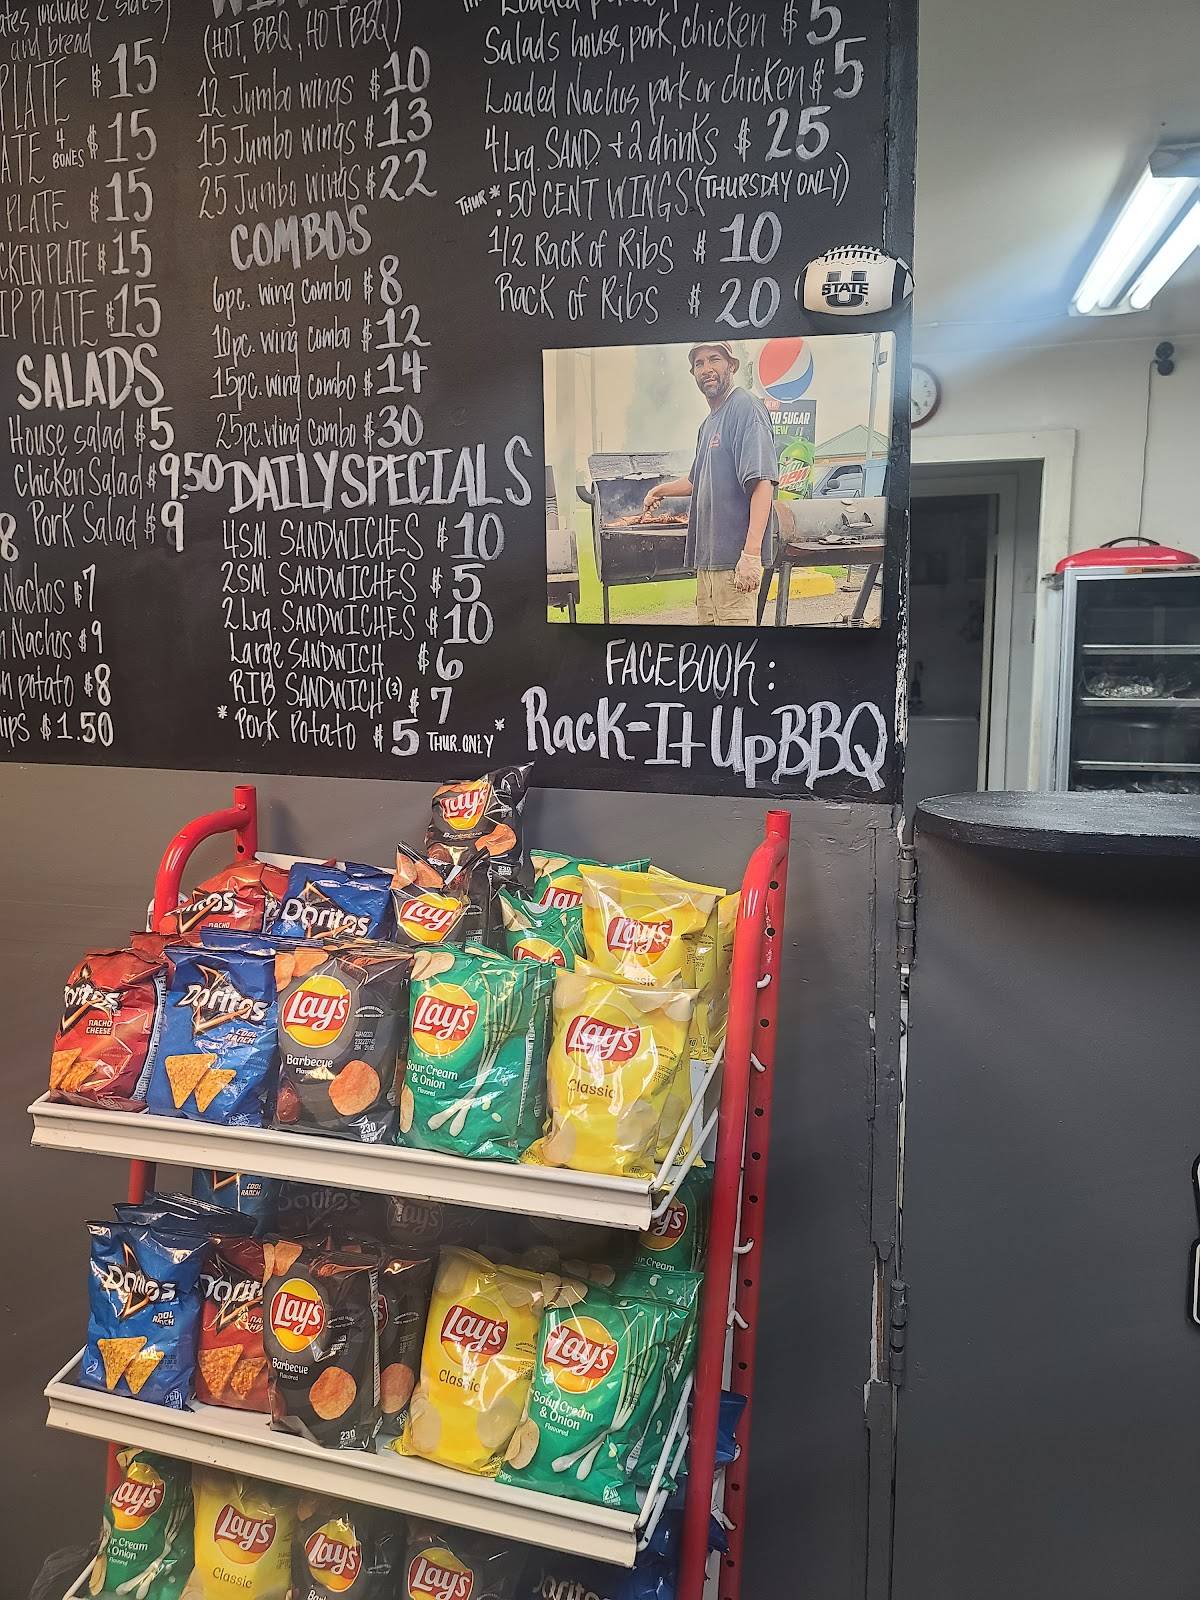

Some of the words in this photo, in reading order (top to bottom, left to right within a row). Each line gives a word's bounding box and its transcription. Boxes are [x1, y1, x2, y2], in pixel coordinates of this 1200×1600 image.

[11, 27, 40, 61] and
[49, 22, 93, 58] bread
[306, 5, 347, 50] HOT
[483, 17, 560, 65] Salads
[681, 1, 767, 50] chicken
[0, 57, 70, 131] PLATE
[197, 77, 227, 118] 12
[229, 67, 292, 117] Jumbo
[299, 73, 355, 126] wings
[486, 70, 558, 119] Loaded
[566, 62, 640, 117] Nachos
[649, 62, 692, 127] pork
[696, 78, 716, 103] or
[721, 54, 805, 107] chicken
[52, 148, 85, 169] BONES
[56, 128, 67, 150] 4
[196, 123, 228, 169] 15
[231, 116, 293, 165] Jumbo
[300, 119, 357, 168] wings
[545, 126, 601, 171] SAND.
[648, 112, 719, 166] drinks
[6, 190, 69, 233] PLATE
[199, 174, 228, 219] 25
[232, 166, 298, 216] Jumbo
[304, 163, 361, 222] wings
[541, 175, 600, 221] CENT
[606, 167, 693, 223] WINGS
[230, 204, 372, 271] COMBOS
[487, 225, 528, 268] 1/2
[536, 230, 586, 270] Rack
[588, 229, 609, 269] of
[618, 226, 674, 275] Ribs
[47, 240, 94, 286] PLATE
[213, 276, 251, 321] 6pc.
[258, 276, 297, 327] wing
[494, 272, 556, 320] Rack
[567, 275, 590, 321] of
[600, 271, 660, 325] Ribs
[821, 282, 869, 297] STATE
[31, 289, 98, 347] PLATE
[212, 323, 255, 368] 10pc.
[260, 322, 299, 374] wing
[17, 343, 165, 411] SALADS
[265, 368, 302, 421] wing
[9, 414, 67, 456] House
[783, 411, 811, 425] SUGAR
[89, 453, 144, 500] Salad
[27, 499, 76, 549] Pork
[83, 497, 138, 551] Salad
[280, 512, 424, 561] SANDWICHES
[3, 562, 65, 614] Nachos
[278, 562, 417, 602] SANDWICHES
[12, 617, 72, 660] Nachos
[282, 600, 416, 641] SANDWICHES
[230, 632, 284, 674] Large
[288, 638, 385, 680] SANDWICH
[18, 663, 74, 710] potato
[229, 669, 276, 706] RIB
[285, 672, 385, 719] SANDWICH
[235, 707, 280, 745] Pork
[289, 711, 356, 751] Potato
[279, 897, 371, 942] Doritos
[609, 917, 673, 955] Lay's
[88, 1019, 113, 1027] NACHO
[178, 984, 269, 1021] Doritos
[285, 991, 350, 1031] Lay's
[414, 996, 477, 1041] Lay's
[86, 1027, 112, 1036] CHEESE
[225, 1034, 256, 1045] RANCH
[235, 1028, 257, 1039] COOL
[567, 1016, 639, 1060] Lay's
[286, 1053, 334, 1068] Barbecue
[406, 1059, 425, 1074] Sour
[426, 1063, 459, 1081] Cream
[411, 1073, 419, 1084] &
[420, 1075, 446, 1090] Onion
[567, 1077, 617, 1099] Classic
[359, 1121, 377, 1134] 230
[245, 1182, 262, 1190] COOL
[273, 1292, 324, 1338] Lay's
[442, 1305, 506, 1353] Lay's
[272, 1356, 309, 1374] Barbecue
[547, 1326, 617, 1374] Lay's
[539, 1407, 549, 1418] &
[549, 1410, 581, 1431] Onion
[560, 1400, 594, 1423] Cream
[340, 1431, 356, 1442] 230
[111, 1481, 162, 1517] Lay's
[118, 1537, 148, 1551] Cream
[216, 1507, 275, 1553] Lay's
[112, 1546, 137, 1561] Onion
[308, 1534, 358, 1576] Lay's
[212, 1566, 254, 1590] Classic
[411, 1558, 471, 1600] Lay's
